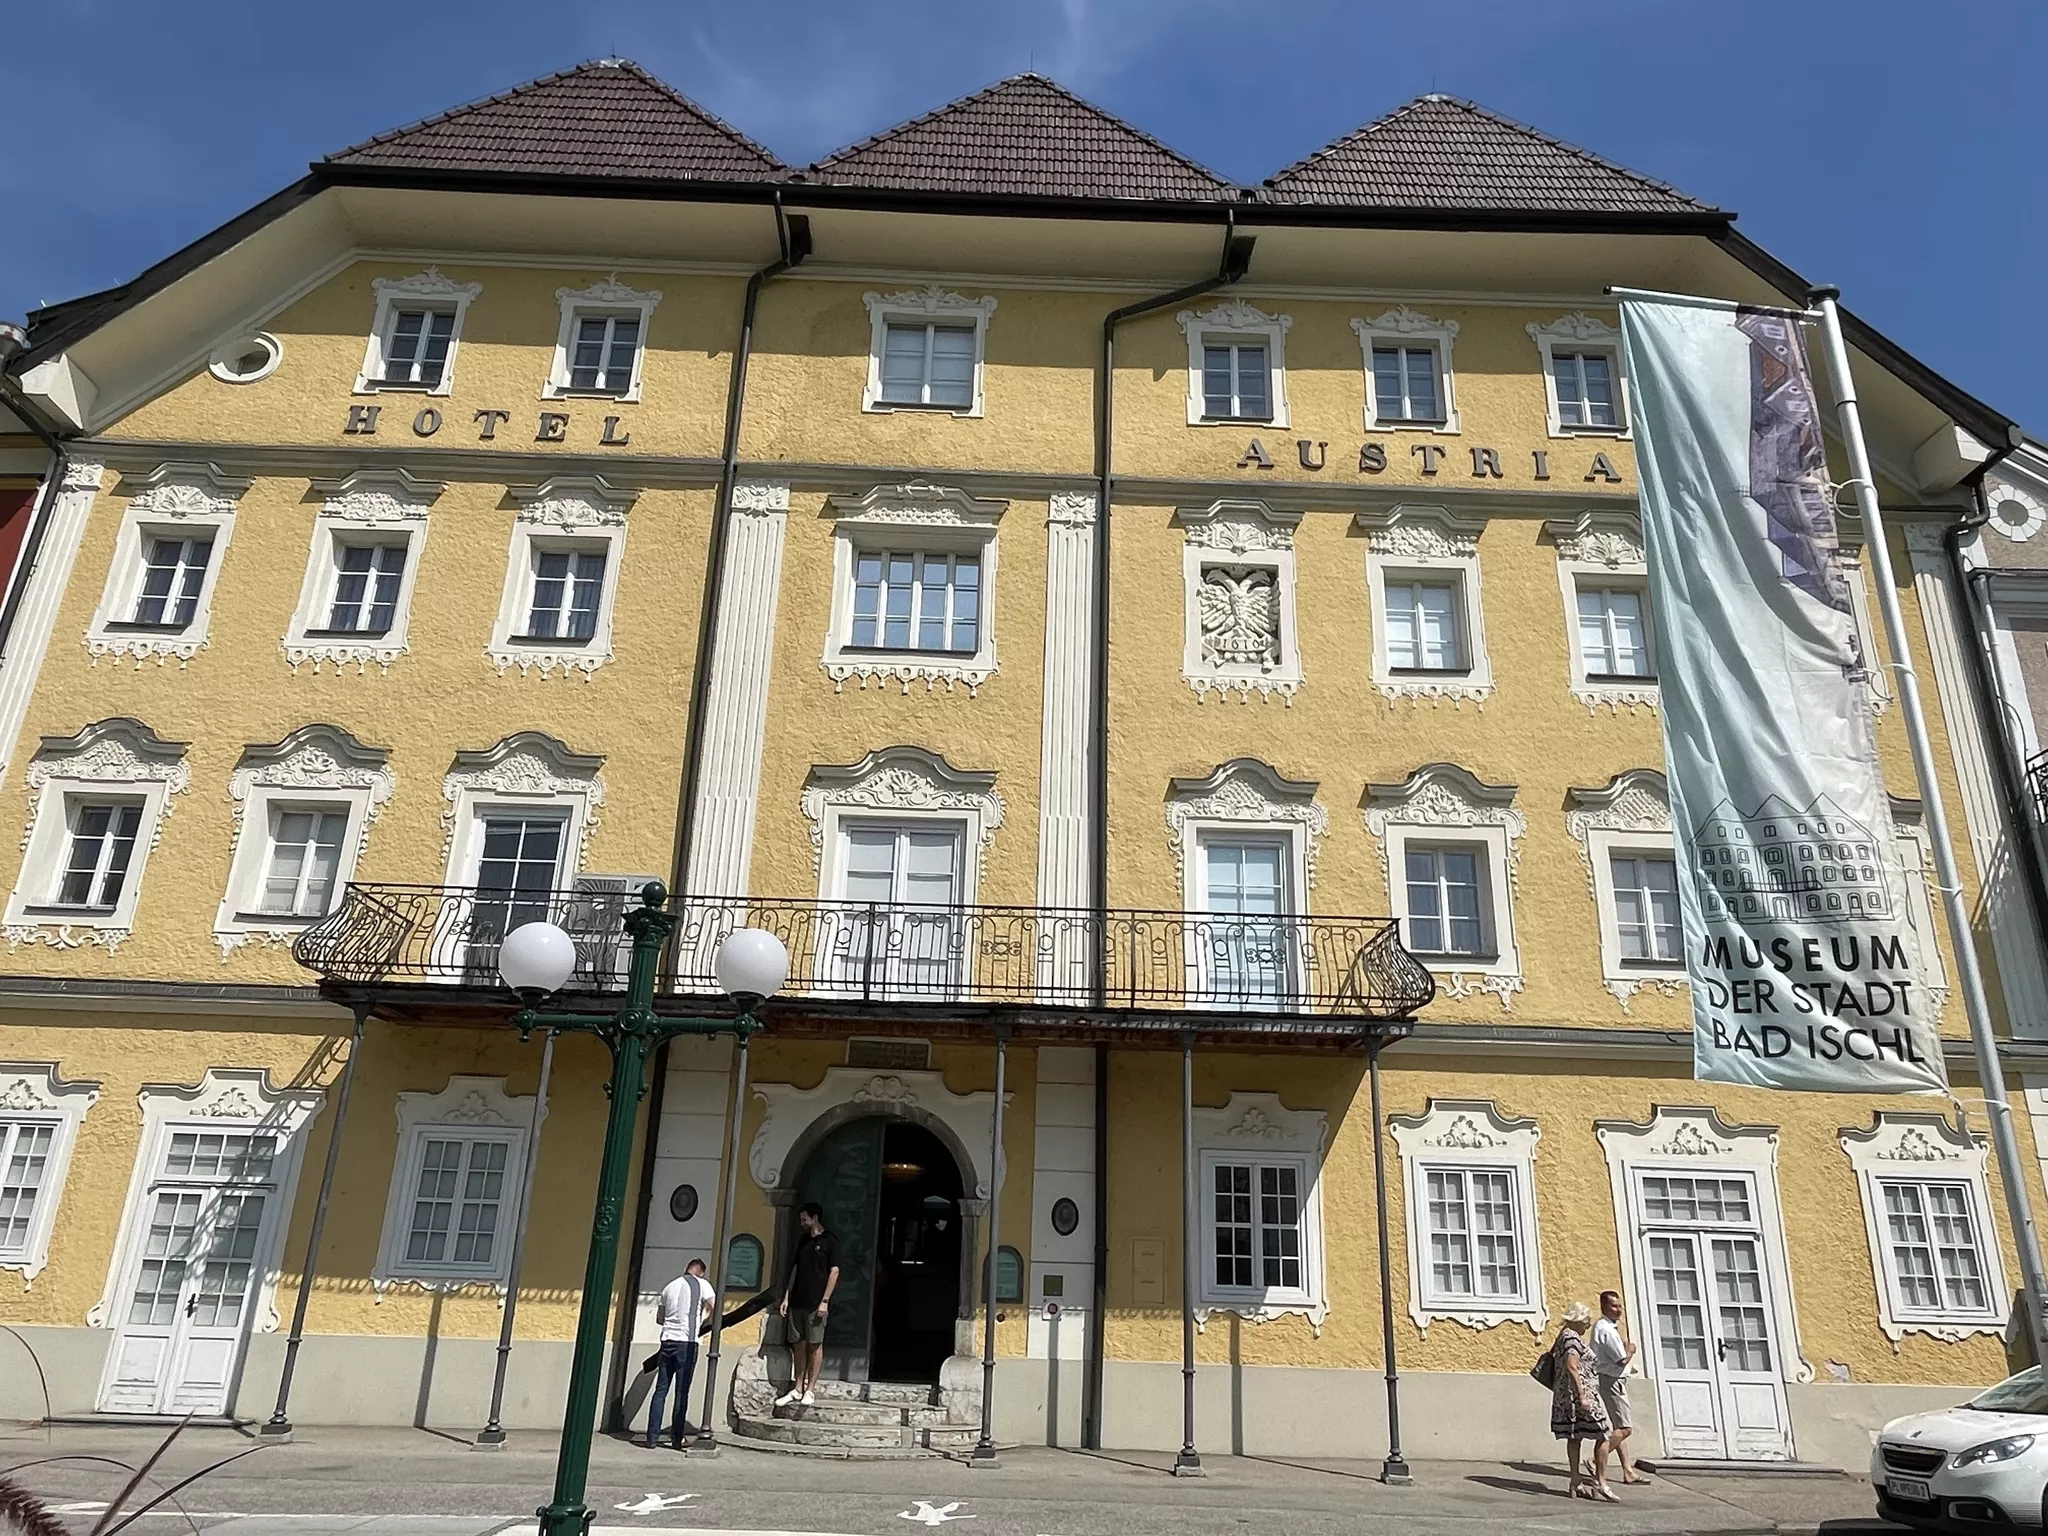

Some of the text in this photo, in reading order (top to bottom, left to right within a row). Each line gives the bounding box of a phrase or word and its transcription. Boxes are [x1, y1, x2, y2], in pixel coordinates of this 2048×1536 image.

[343, 405, 1623, 483] HOTEL AUSTRIA
[1702, 934, 1909, 973] MUSEUM
[1704, 976, 1912, 1018] DER STADT
[1711, 1017, 1925, 1063] BAD ISCHL
